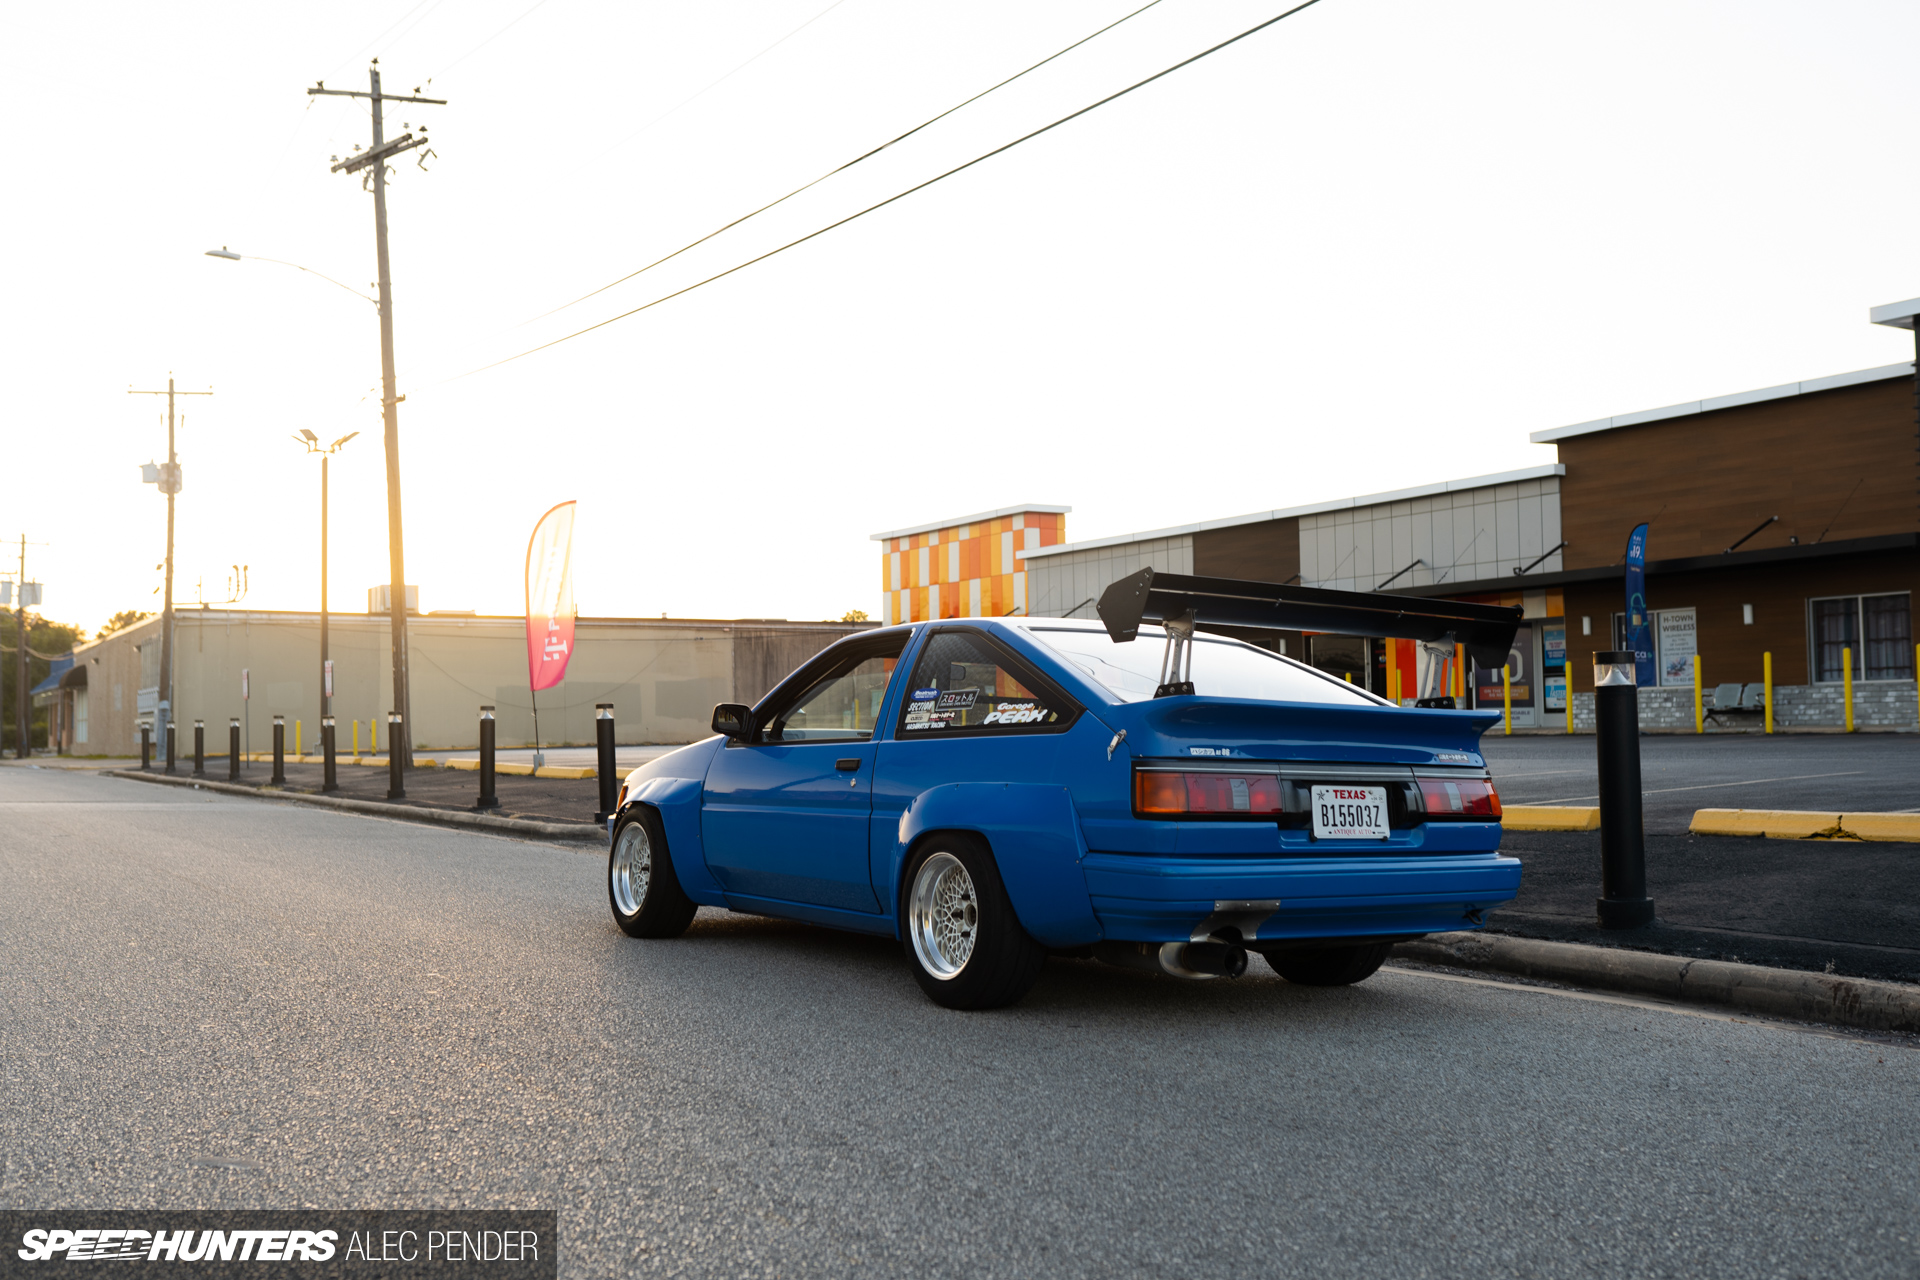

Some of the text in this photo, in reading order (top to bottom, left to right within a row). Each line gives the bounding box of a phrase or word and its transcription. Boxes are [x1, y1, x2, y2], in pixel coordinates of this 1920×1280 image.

[1663, 615, 1693, 624] H-TOWN
[1662, 623, 1695, 633] WIRELESS
[997, 702, 1034, 710] Garage
[984, 709, 1048, 725] PEAK
[1333, 789, 1366, 800] TEXAS
[1321, 804, 1382, 828] B15503Z
